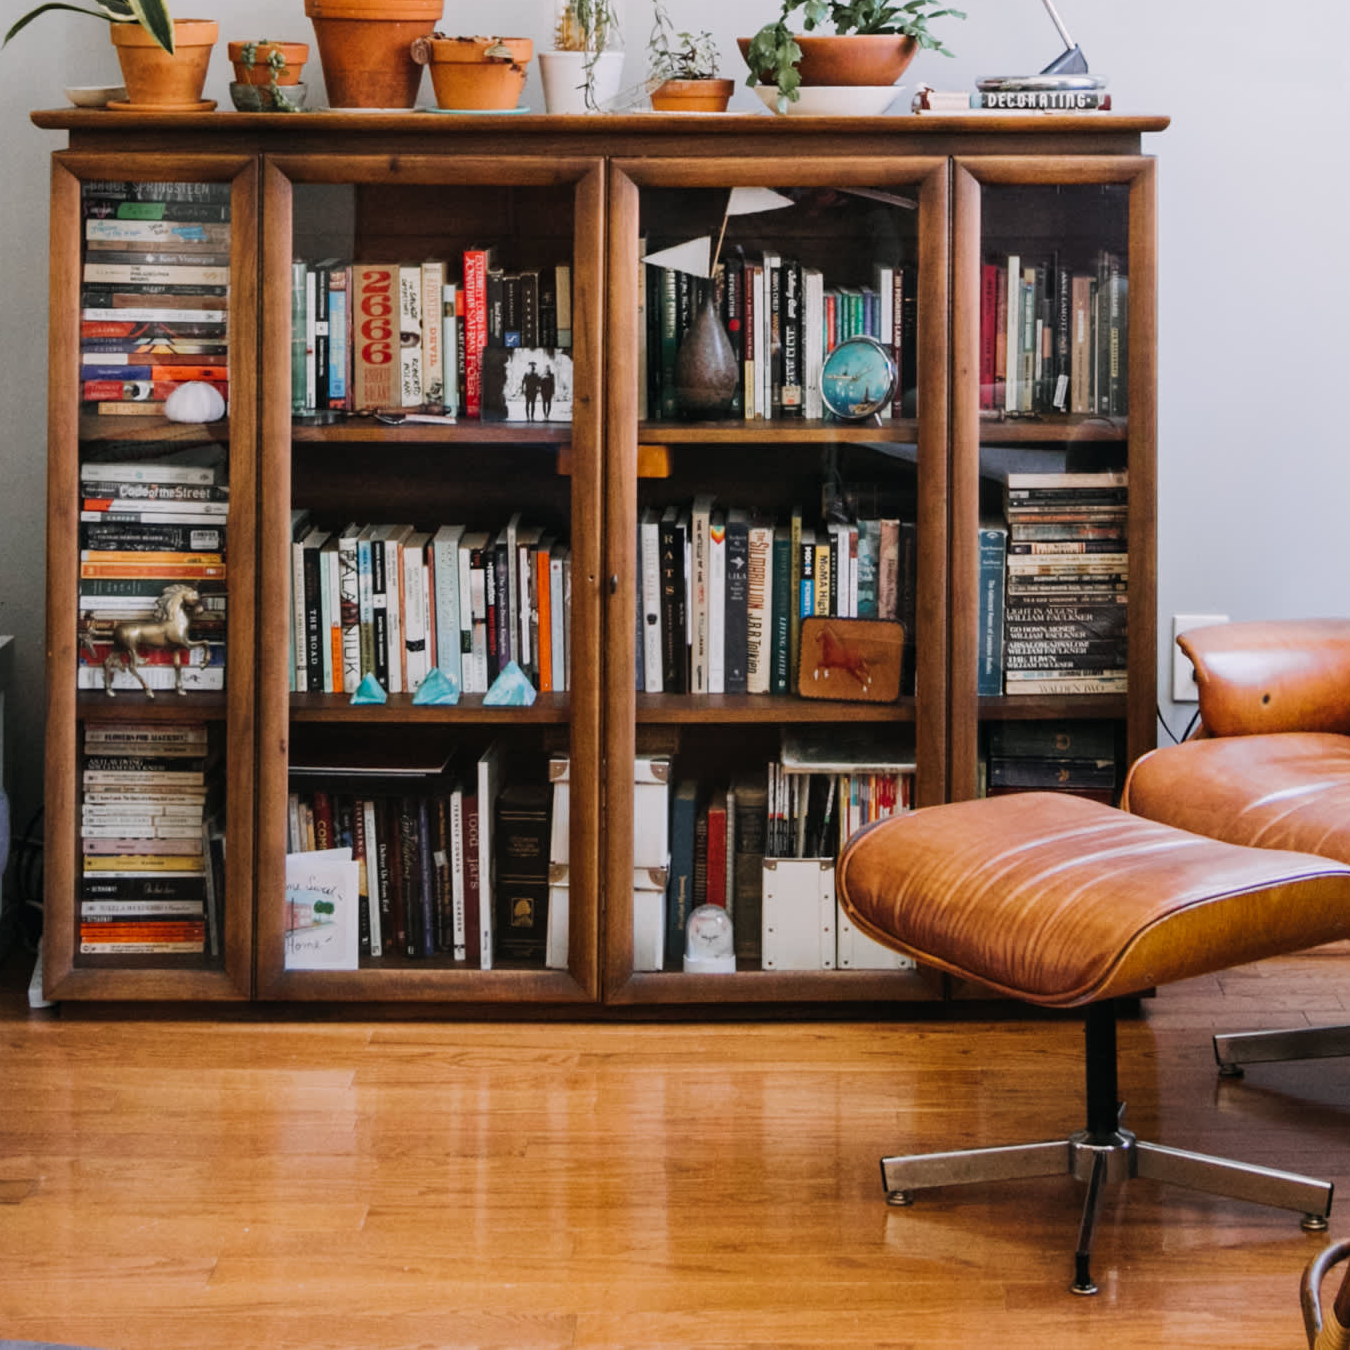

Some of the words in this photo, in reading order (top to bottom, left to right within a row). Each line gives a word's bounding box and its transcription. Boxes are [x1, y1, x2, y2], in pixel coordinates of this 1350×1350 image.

[987, 93, 1087, 108] DECORATING
[133, 181, 210, 195] SPRINGSTEEN
[466, 256, 477, 308] JONATHAN
[361, 270, 393, 365] 2666
[466, 310, 477, 353] SAFRAN
[120, 485, 150, 497] Code
[175, 486, 211, 499] Street
[664, 534, 675, 596] RATS
[748, 540, 769, 610] SILMARILLION
[818, 554, 828, 589] MoMA
[486, 566, 496, 605] revolution
[817, 590, 829, 614] High
[309, 609, 318, 631] THE
[310, 635, 319, 665] ROAD
[499, 628, 508, 655] Kingdom
[747, 641, 762, 675] Tolkien
[466, 857, 480, 890] jars
